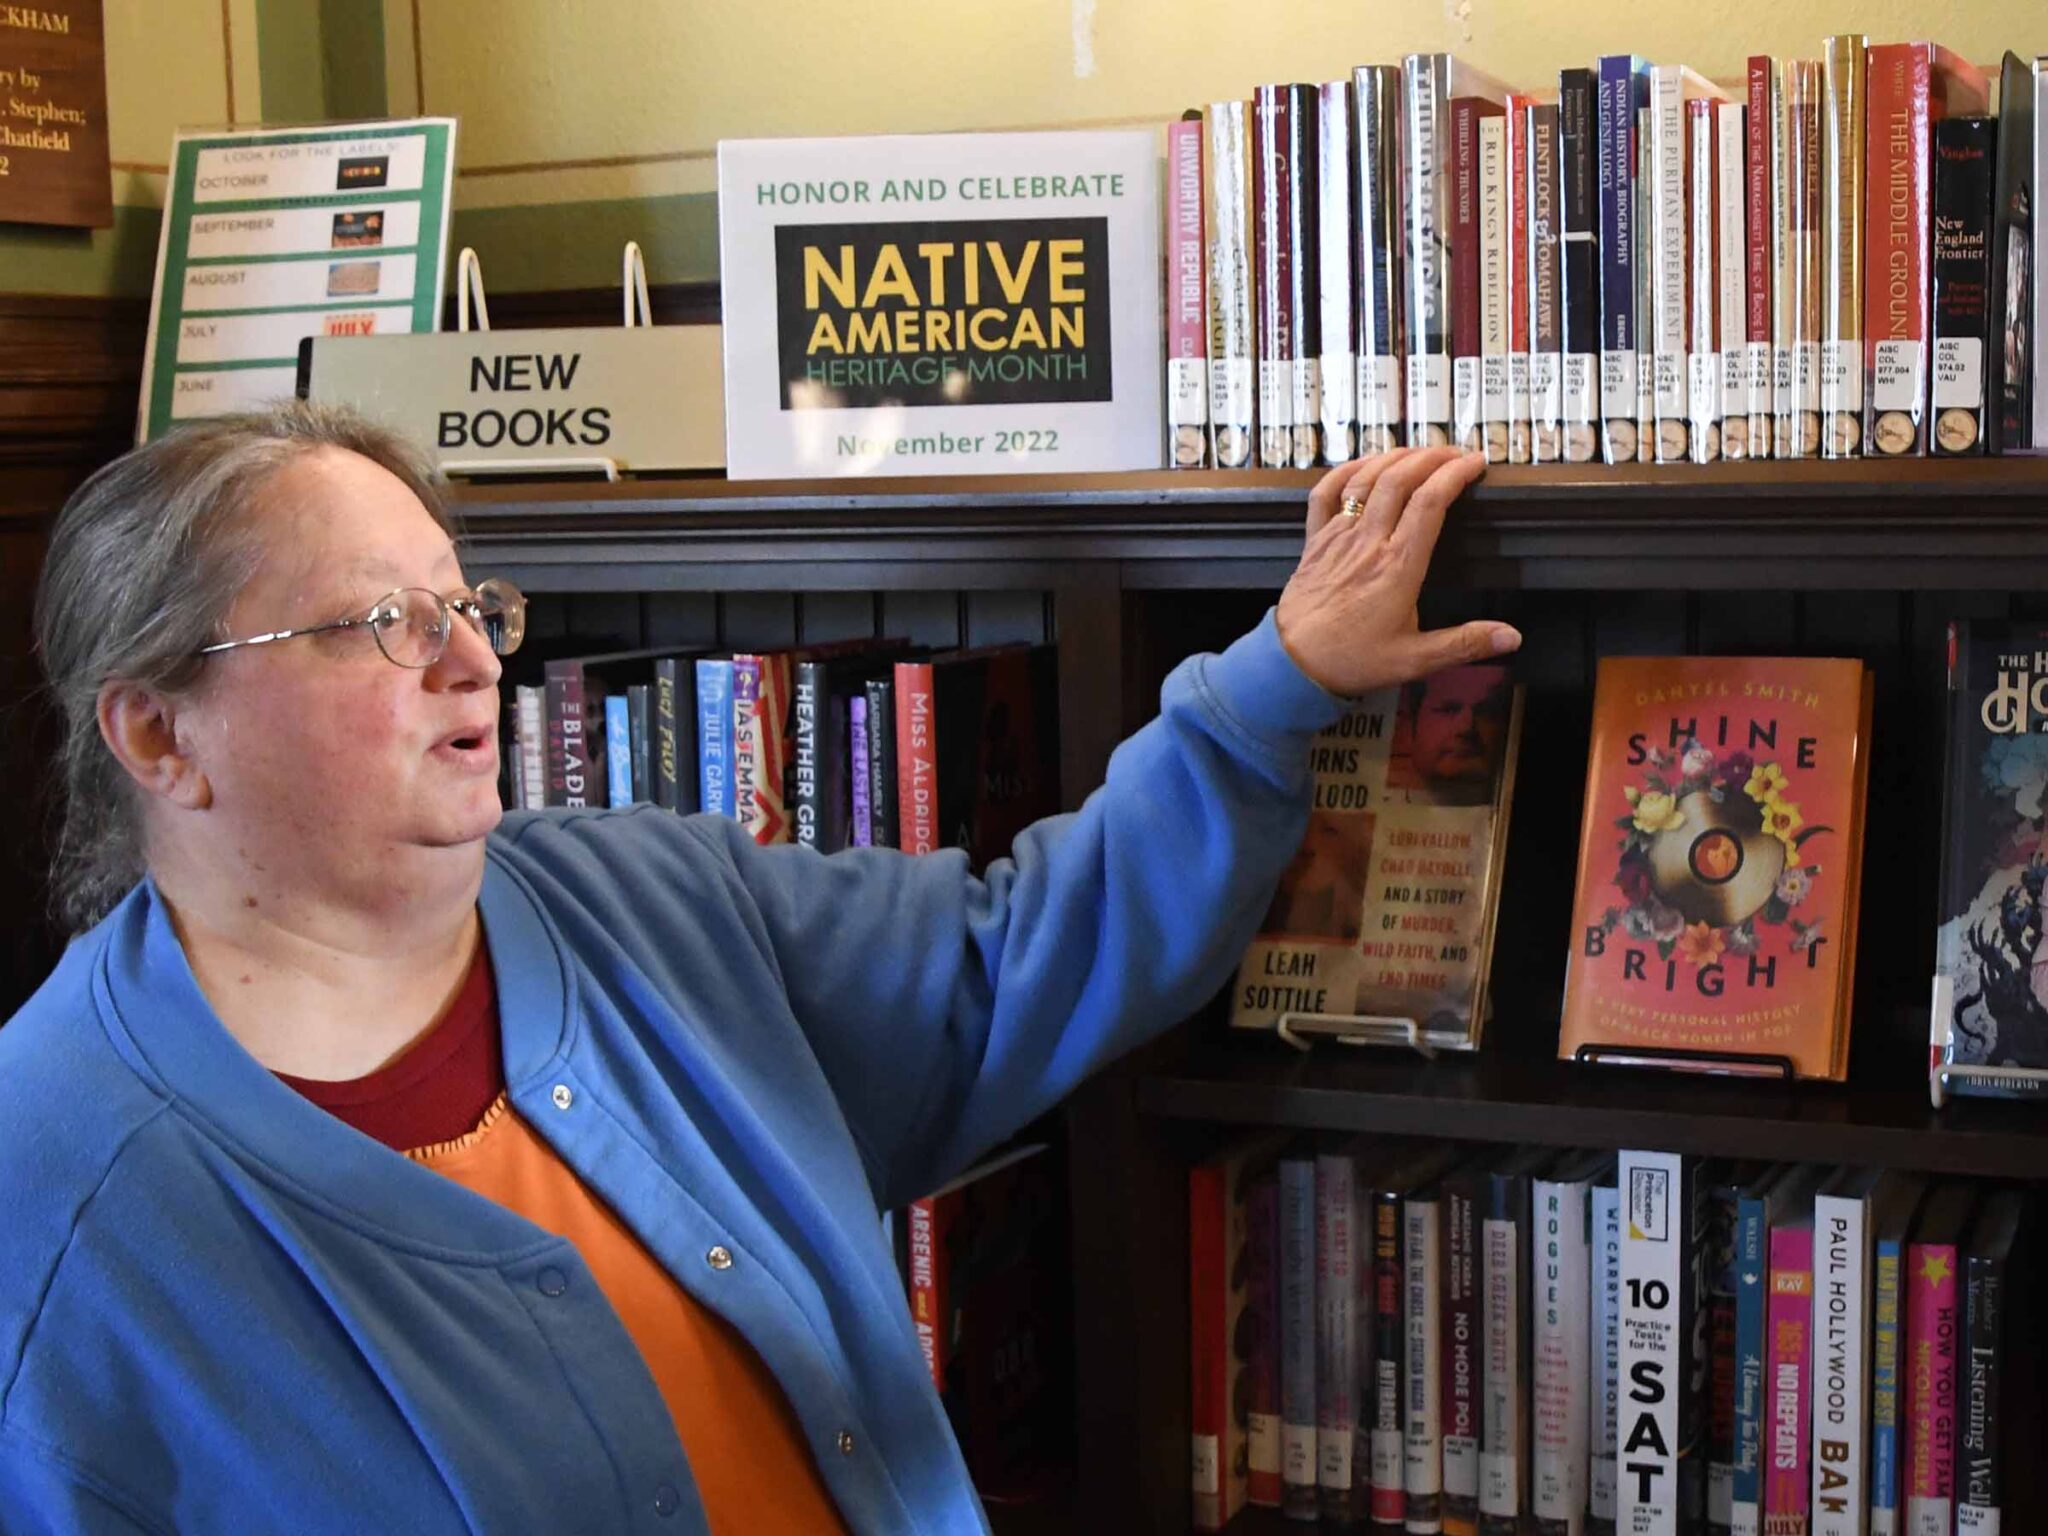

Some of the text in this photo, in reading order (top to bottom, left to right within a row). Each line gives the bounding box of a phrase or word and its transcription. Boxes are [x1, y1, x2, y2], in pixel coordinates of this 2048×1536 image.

[20, 67, 40, 95] by
[1616, 79, 1628, 126] INDIAN
[1601, 81, 1613, 190] AND GENEALOGY
[1664, 105, 1678, 138] THE
[1752, 127, 1762, 140] OF
[1890, 109, 1909, 154] THE
[223, 151, 263, 164] LOOK
[270, 148, 299, 160] FOR
[307, 146, 332, 157] THE
[1458, 107, 1471, 224] WHIRLING THUNDER
[1752, 144, 1762, 164] THE
[199, 174, 268, 189] OCTOBER
[1536, 124, 1550, 219] FLINTLOCK
[1665, 147, 1679, 219] PURITAN
[757, 174, 1125, 206] HONOR AND CELEBRATE
[1890, 158, 1909, 239] MIDDLE
[195, 217, 275, 234] SEPTEMBER
[1179, 133, 1202, 324] UNWORTHY REPUBLIC
[1617, 189, 1629, 265] BIOGRAPHY
[1936, 216, 1964, 230] New
[1936, 231, 1984, 249] England
[1485, 141, 1500, 343] RED REBELLION
[1936, 246, 1985, 260] Frontier
[188, 272, 246, 286] AUGUST
[803, 239, 1086, 309] NATIVE
[1538, 237, 1552, 338] TOMAHAWK
[1666, 227, 1680, 340] EXPERIMENT
[1753, 276, 1763, 289] OF
[183, 325, 217, 338] JULY
[806, 306, 1086, 355] AMERICAN
[470, 353, 581, 392] NEW
[806, 354, 1088, 388] HERITAGE MONTH
[1878, 356, 1896, 364] COL
[1938, 353, 1956, 361] COL
[178, 379, 214, 392] JUNE
[1877, 377, 1895, 385] WHI
[1938, 374, 1957, 382] VAU
[437, 407, 611, 447] BOOKS
[837, 430, 1059, 456] Noember 2022
[1998, 655, 2028, 667] THE
[1744, 683, 1819, 708] SMITH
[704, 710, 722, 758] JULIE
[797, 683, 815, 797] HEATHER
[869, 692, 883, 759] BARBARA
[1627, 715, 1818, 769] SHINE
[562, 719, 586, 809] BLADE
[1315, 784, 1368, 808] LOOD
[1384, 886, 1466, 904] AND A STORY
[1382, 914, 1398, 930] OF
[1264, 951, 1316, 977] LEAH
[1363, 942, 1393, 958] WILD
[1440, 946, 1468, 962] AND
[1584, 926, 1828, 997] BRIGHT
[1244, 987, 1327, 1014] SOTTILE
[1644, 1173, 1654, 1229] Princeton
[1655, 1174, 1664, 1195] The
[911, 1205, 932, 1287] ARSENIC
[1547, 1196, 1559, 1325] ROGUES
[1626, 1278, 1670, 1310] 10
[1776, 1278, 1804, 1292] RAY
[1455, 1312, 1470, 1340] NO
[1606, 1207, 1618, 1442] WE CARRY THEIR BONES
[1625, 1318, 1671, 1332] Practice
[1634, 1329, 1663, 1341] Tests
[1826, 1217, 1848, 1425] PAUL HOLLYWOOD
[1936, 1308, 1953, 1358] HOW
[1629, 1339, 1667, 1351] for the
[1455, 1344, 1470, 1396] MORE
[1776, 1363, 1799, 1388] NO
[1914, 1340, 1932, 1411] NICOLE
[1935, 1366, 1952, 1408] YOU
[1963, 1346, 1995, 1450] Listening
[1455, 1402, 1470, 1436] POL
[1624, 1360, 1670, 1504] SAT
[1775, 1391, 1799, 1470] REPEATS
[1935, 1416, 1951, 1450] GET
[1968, 1457, 1993, 1507] Well
